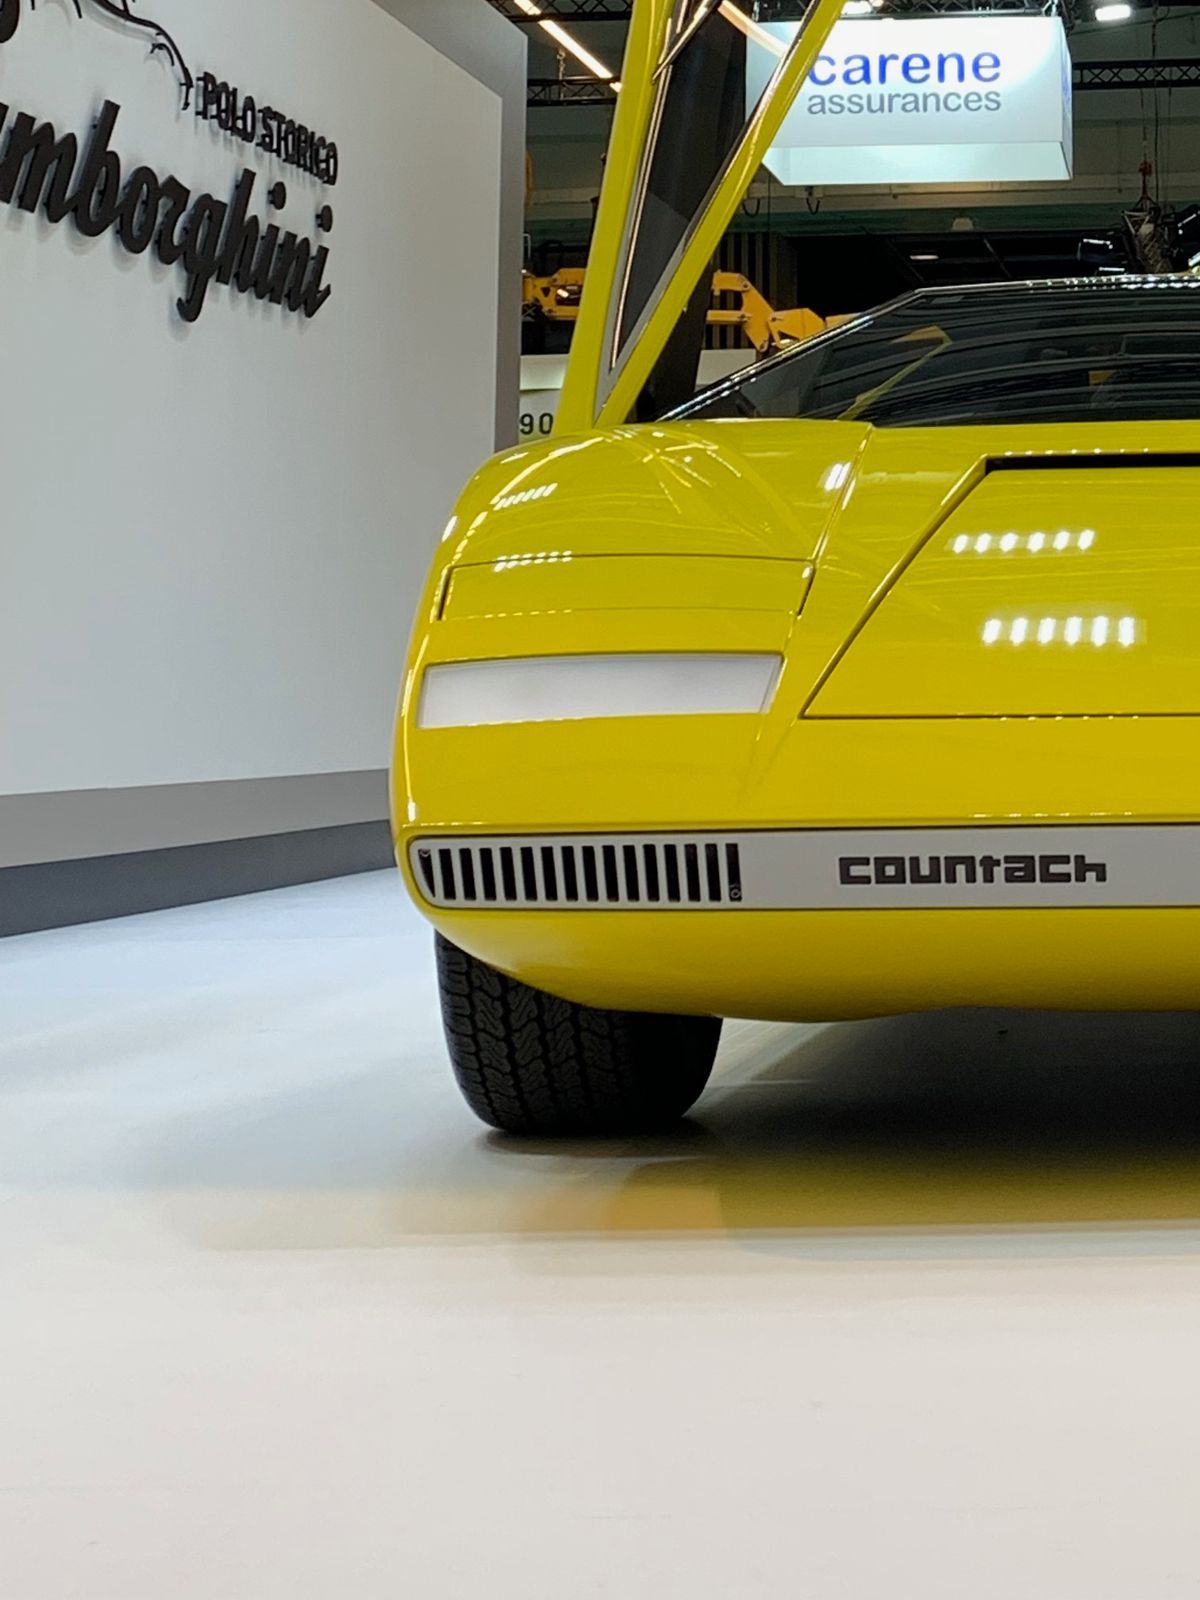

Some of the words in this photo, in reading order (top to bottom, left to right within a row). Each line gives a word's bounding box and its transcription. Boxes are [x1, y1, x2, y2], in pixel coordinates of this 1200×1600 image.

[808, 50, 1001, 86] carene
[807, 89, 1002, 115] assurances
[202, 71, 257, 143] POLO
[260, 105, 339, 186] STORICO
[0, 99, 334, 323] mborghini
[838, 854, 1108, 886] countach
